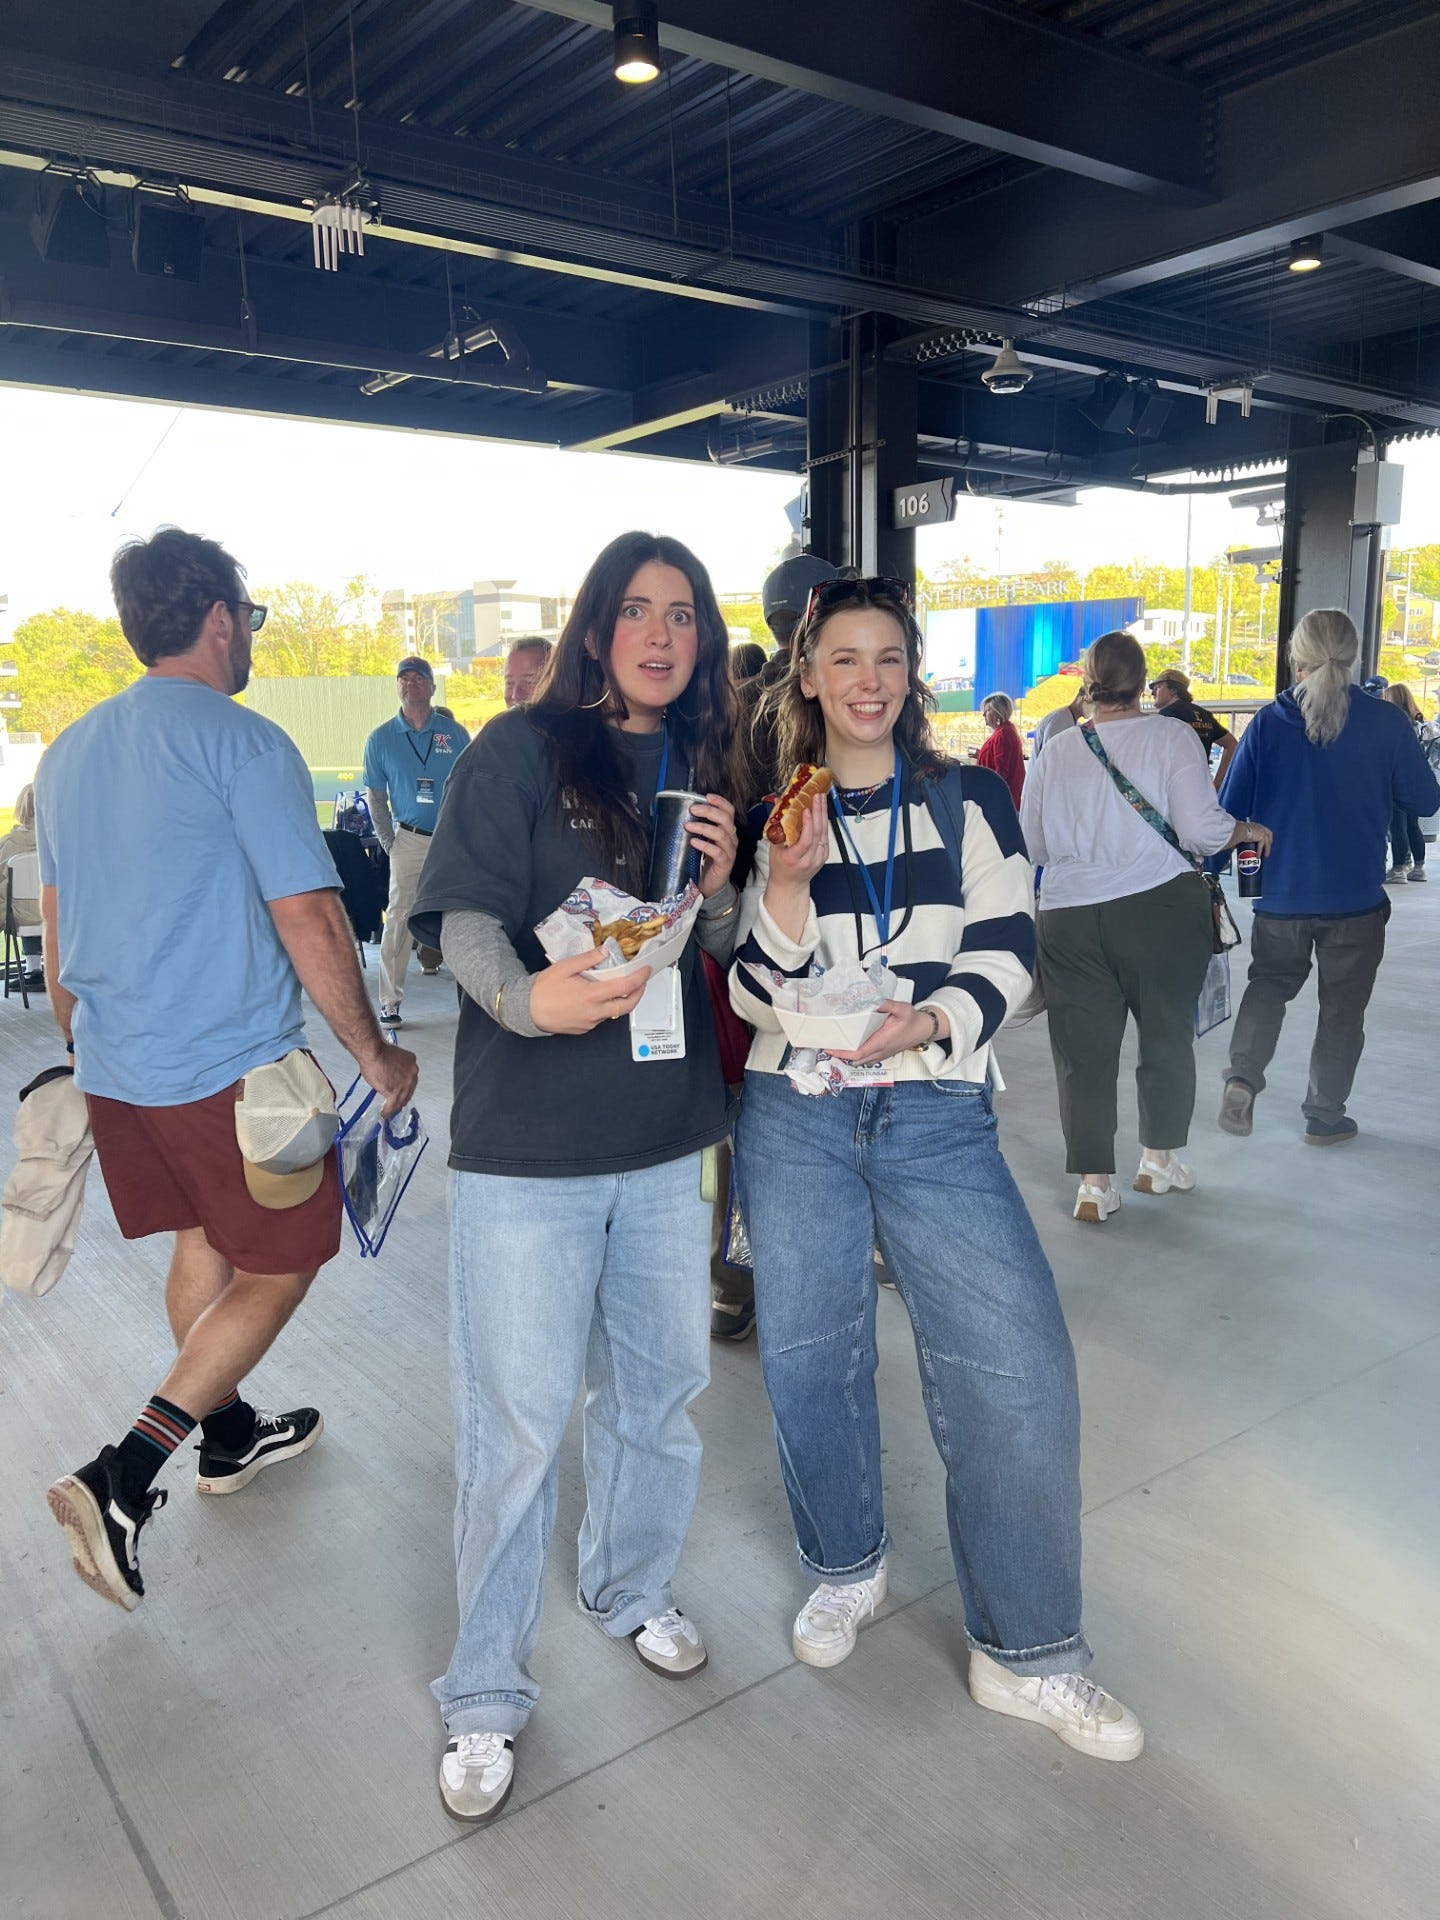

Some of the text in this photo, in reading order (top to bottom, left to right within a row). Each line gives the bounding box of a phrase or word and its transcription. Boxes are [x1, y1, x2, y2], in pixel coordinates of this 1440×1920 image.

[900, 493, 929, 517] 106
[951, 584, 1016, 602] HEALTH
[1024, 580, 1071, 596] PARK
[337, 772, 354, 780] 400
